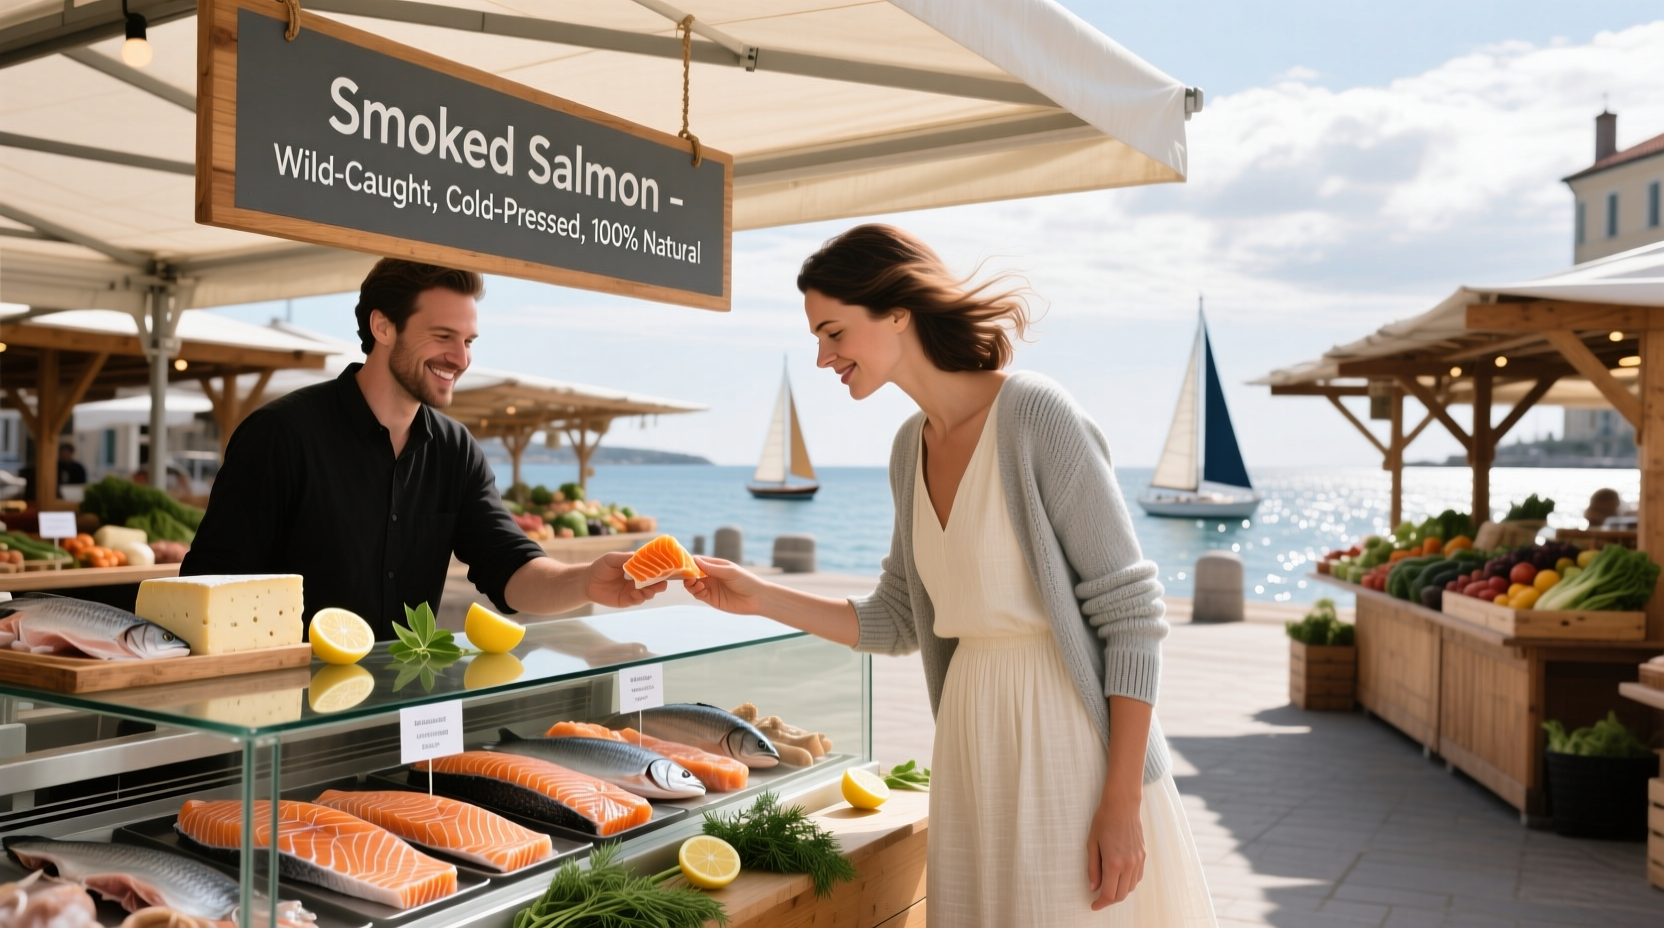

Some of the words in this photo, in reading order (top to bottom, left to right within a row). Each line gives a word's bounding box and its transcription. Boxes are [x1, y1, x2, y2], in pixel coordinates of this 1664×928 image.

[273, 142, 438, 214] Wild-Caught,
[446, 184, 586, 245] Cold-Pressed,
[591, 217, 639, 251] 100%
[643, 228, 701, 265] Natural
[328, 76, 514, 177] Smoked
[527, 134, 659, 213] Salmon
